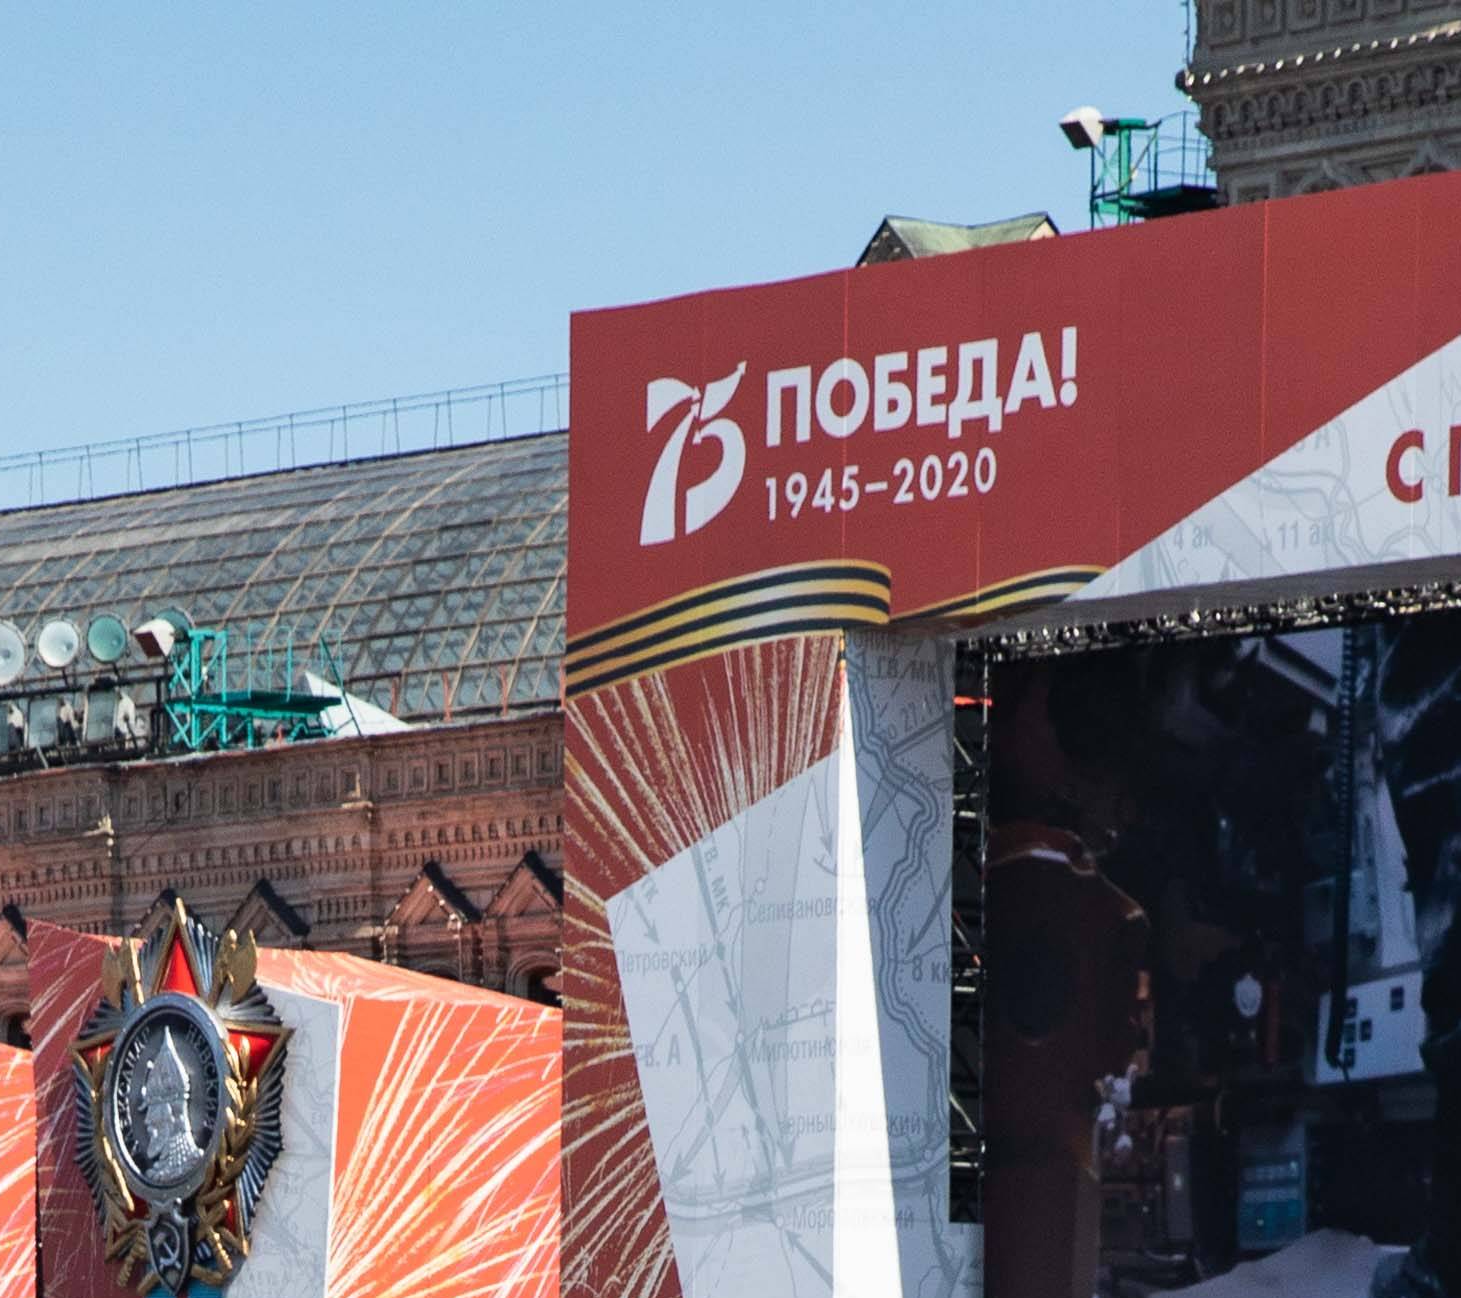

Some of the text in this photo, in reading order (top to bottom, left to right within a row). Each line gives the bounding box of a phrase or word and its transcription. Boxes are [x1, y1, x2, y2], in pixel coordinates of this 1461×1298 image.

[766, 325, 1079, 447] ПОБЕДА!
[639, 361, 747, 546] 75
[1385, 429, 1425, 504] С
